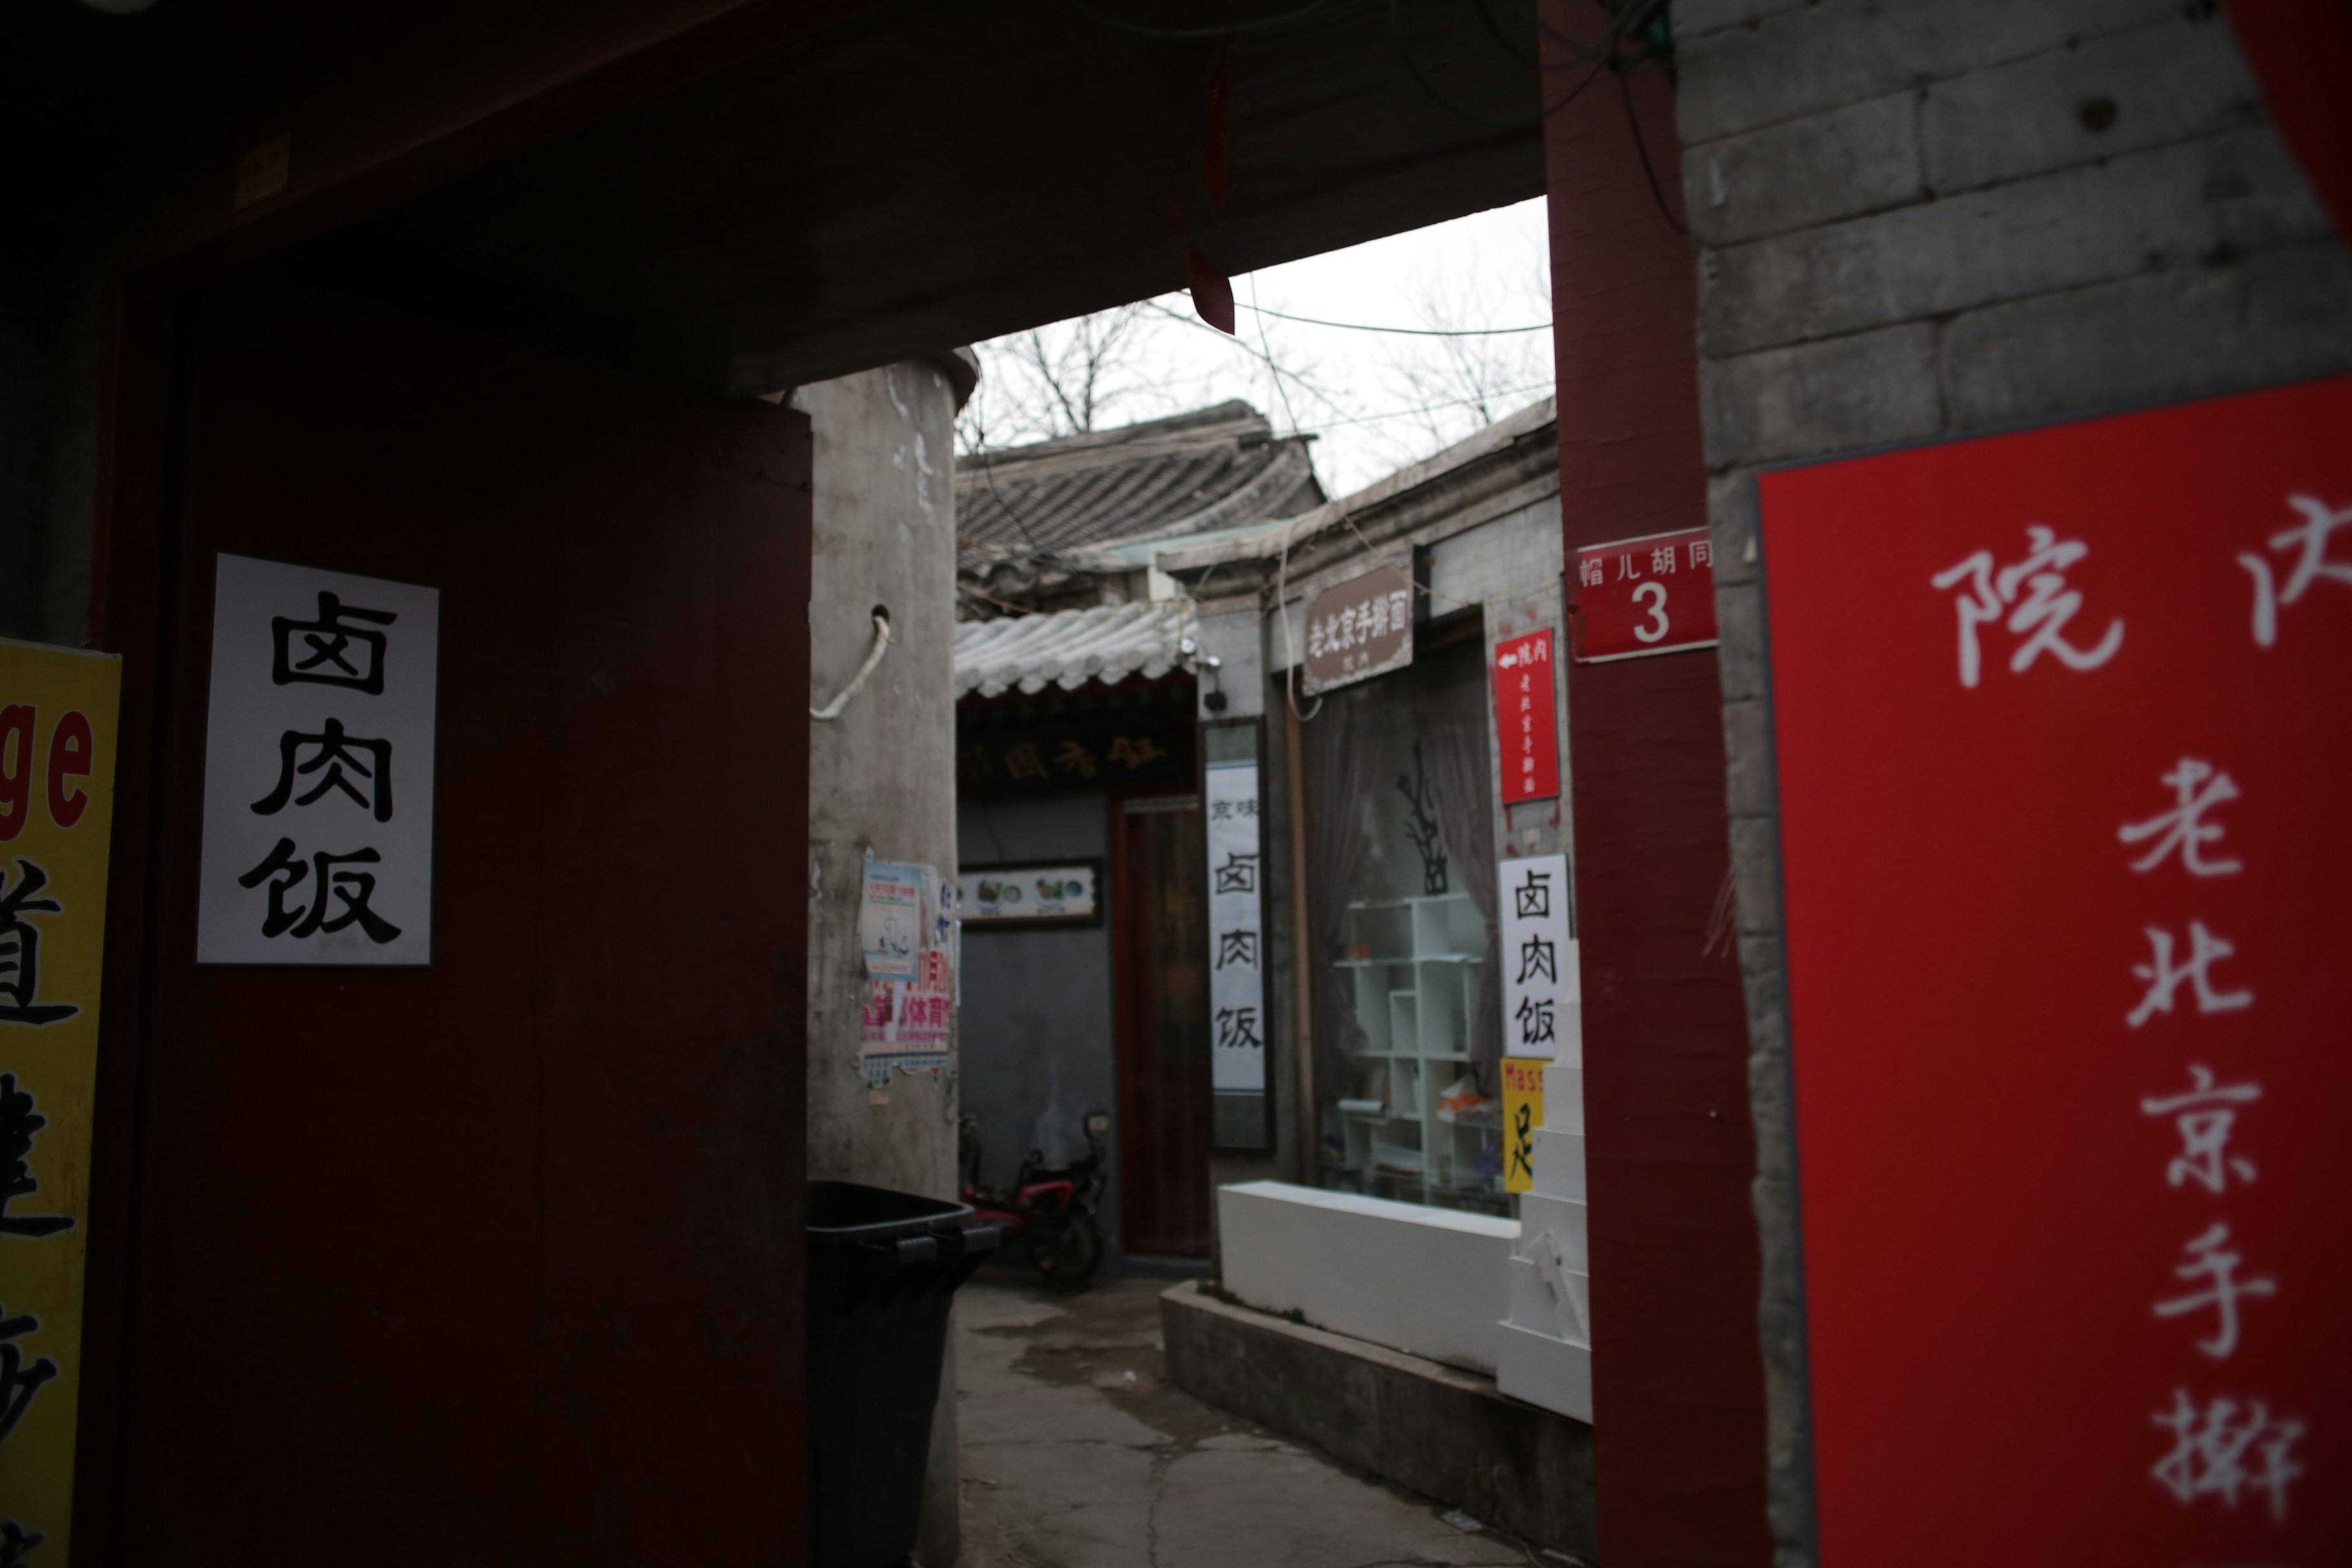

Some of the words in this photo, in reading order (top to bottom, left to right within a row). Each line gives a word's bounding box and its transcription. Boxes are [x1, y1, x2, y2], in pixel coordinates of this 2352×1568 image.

[1579, 540, 1714, 587] 帽儿胡同
[1631, 582, 1670, 643] 3
[238, 591, 402, 943] 卤肉饭
[1211, 798, 1260, 821] 京味
[1215, 852, 1264, 1048] 卤肉饭
[1516, 870, 1558, 1044] 卤肉饭
[2116, 756, 2307, 1568] 老北京手擀
